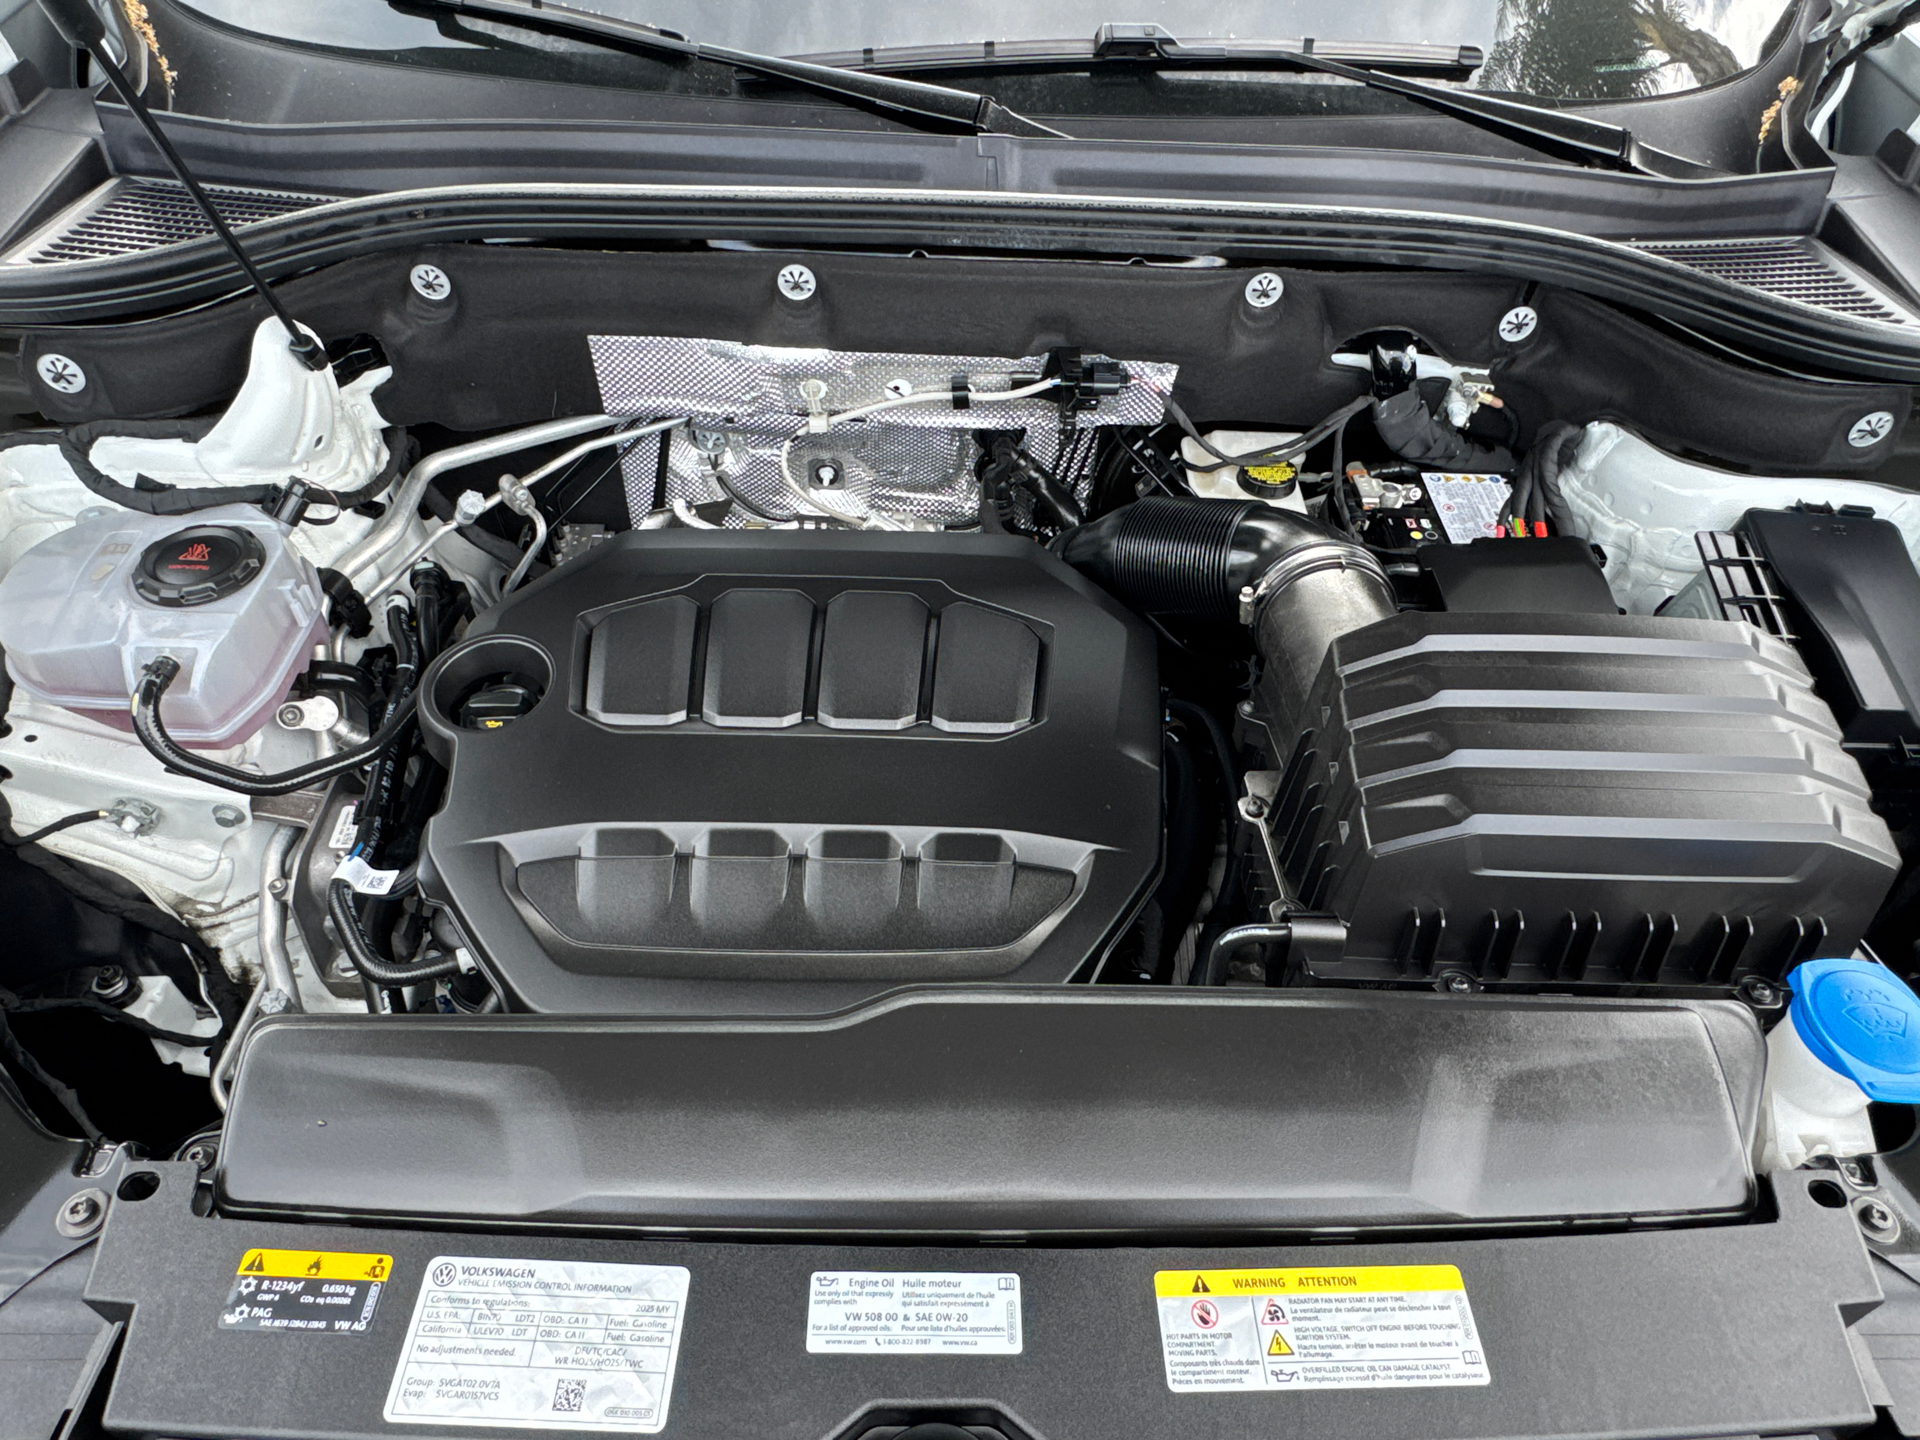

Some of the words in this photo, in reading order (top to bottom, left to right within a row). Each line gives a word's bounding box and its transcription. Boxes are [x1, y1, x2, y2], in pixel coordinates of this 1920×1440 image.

[461, 1266, 536, 1278] VOLKSWAGEN
[261, 1280, 305, 1294] R-1234yf
[458, 1279, 490, 1287] VEHICLE
[492, 1280, 532, 1289] EMISSION
[534, 1281, 571, 1291] CONTROL
[574, 1284, 632, 1293] INFORMATION
[849, 1278, 879, 1289] Engine
[882, 1278, 895, 1288] Oil
[902, 1279, 926, 1288] Huile
[928, 1280, 962, 1288] moteur
[1232, 1278, 1286, 1288] WARNING
[1298, 1276, 1357, 1287] ATTENTION
[322, 1284, 345, 1293] 0.650
[345, 1285, 357, 1296] kg
[828, 1290, 841, 1298] only
[865, 1290, 894, 1299] expressly
[431, 1295, 470, 1305] Conforms
[927, 1292, 965, 1300] uniquement
[814, 1298, 842, 1306] complies
[940, 1300, 984, 1308] expressément
[251, 1307, 273, 1318] PAG
[636, 1304, 655, 1313] 2025
[656, 1305, 670, 1313] MY
[515, 1314, 535, 1323] LDT2
[568, 1316, 580, 1325] CA
[845, 1312, 862, 1321] VW
[865, 1312, 882, 1322] 508
[885, 1312, 898, 1322] 00
[903, 1314, 910, 1322] &
[915, 1313, 933, 1322] SAE
[936, 1313, 968, 1322] 0W-20
[335, 1320, 352, 1330] VW
[351, 1321, 366, 1331] AG
[610, 1318, 629, 1327] Fuel:
[632, 1320, 667, 1329] Gasoline
[422, 1325, 462, 1333] California
[511, 1328, 528, 1336] LDT
[540, 1329, 561, 1338] OBD:
[564, 1330, 577, 1339] CA
[848, 1325, 878, 1333] approved
[606, 1332, 626, 1341] Fuel:
[630, 1334, 665, 1343] Gasoline
[416, 1344, 428, 1353] No
[430, 1345, 482, 1356] adjustments
[1170, 1360, 1208, 1368] Composants
[1178, 1369, 1224, 1377] compartiment
[1302, 1366, 1341, 1374] OVERFILLED
[406, 1376, 435, 1389] Group:
[403, 1388, 426, 1399] Evap:
